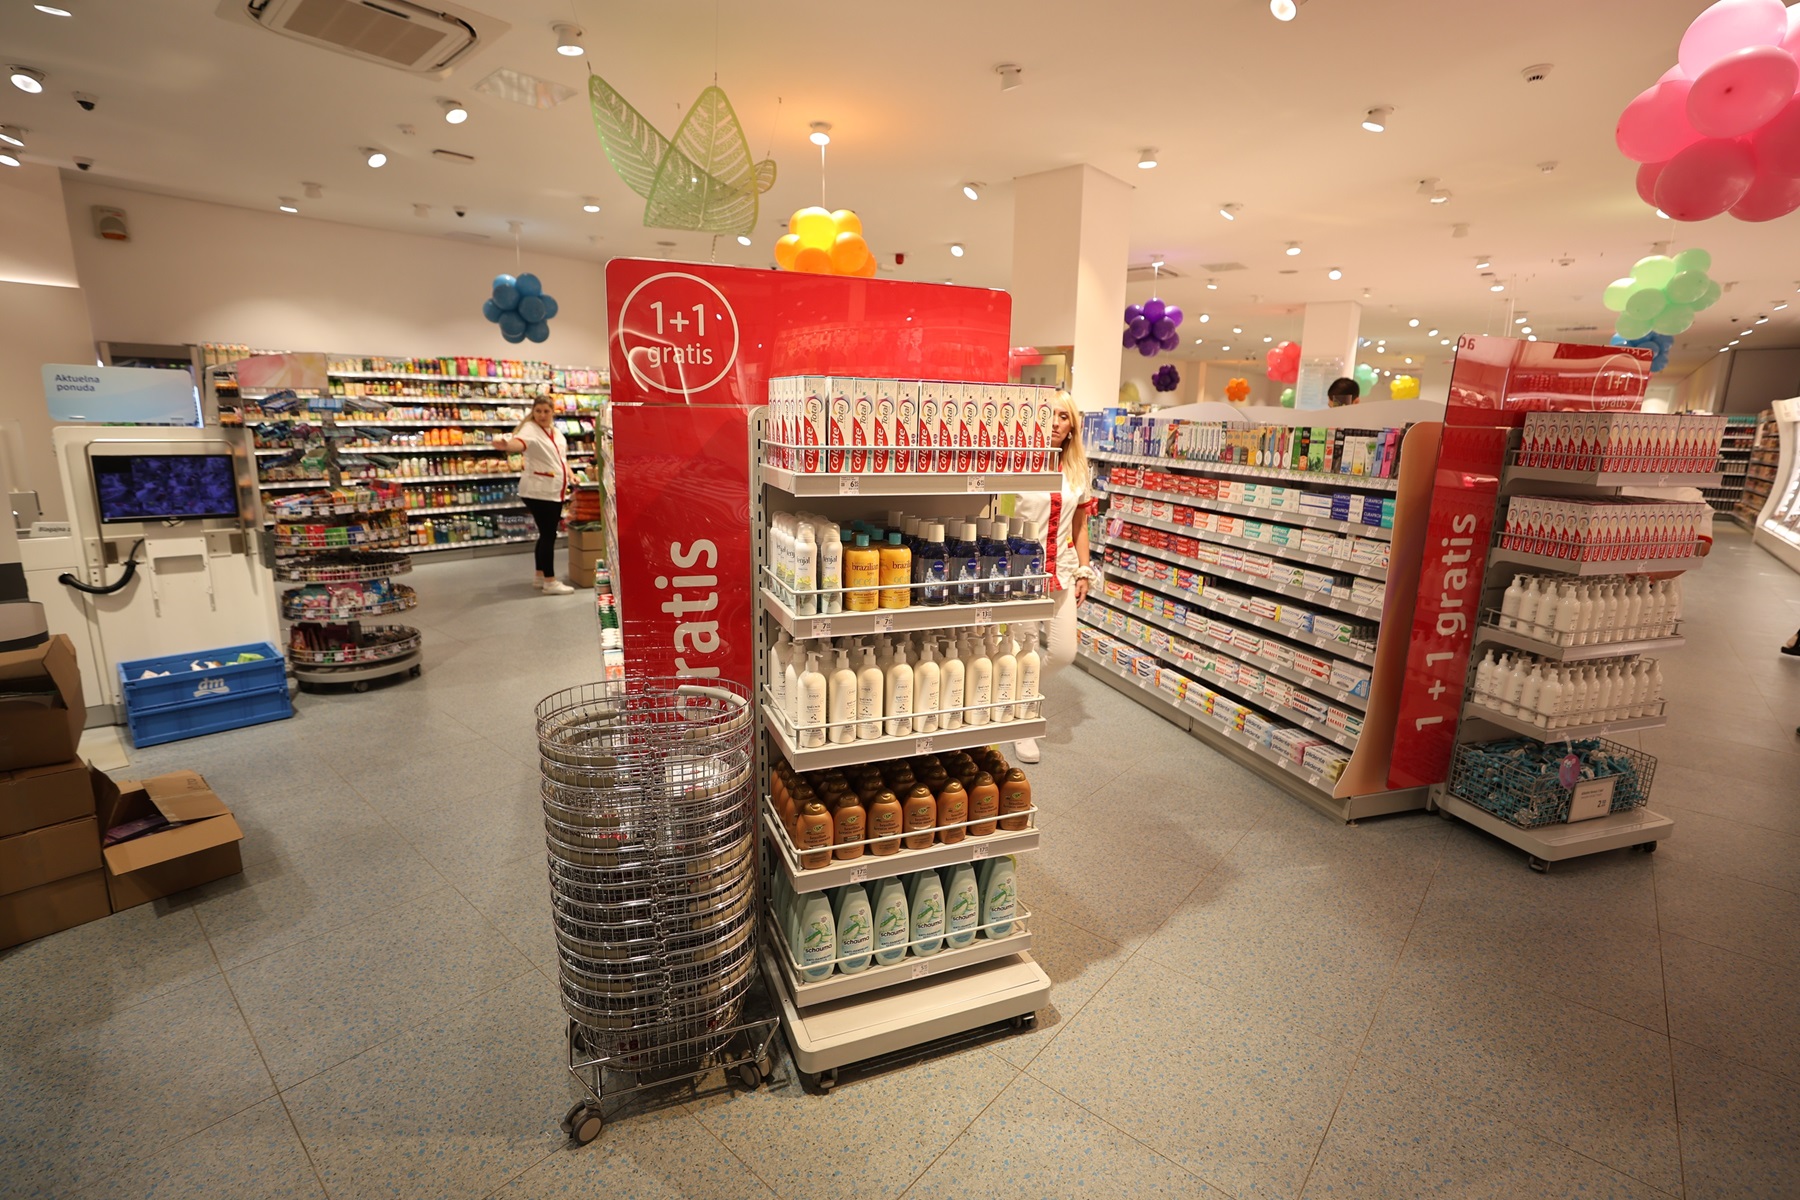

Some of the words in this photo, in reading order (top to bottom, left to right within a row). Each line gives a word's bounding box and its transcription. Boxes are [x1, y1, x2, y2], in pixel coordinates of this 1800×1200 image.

[650, 301, 704, 336] 1+1
[647, 343, 713, 368] gratis
[55, 374, 100, 384] Aktuelna
[56, 383, 96, 392] ponuda
[1600, 395, 1628, 410] gratis
[881, 404, 889, 425] Total
[946, 406, 954, 427] Total
[1435, 513, 1477, 639] gratis
[198, 677, 224, 691] dm
[991, 903, 1014, 912] schauma
[952, 911, 976, 921] schauma
[917, 919, 943, 929] schauma
[880, 927, 906, 937] schauma
[843, 935, 870, 946] schauma
[805, 943, 832, 954] schauma
